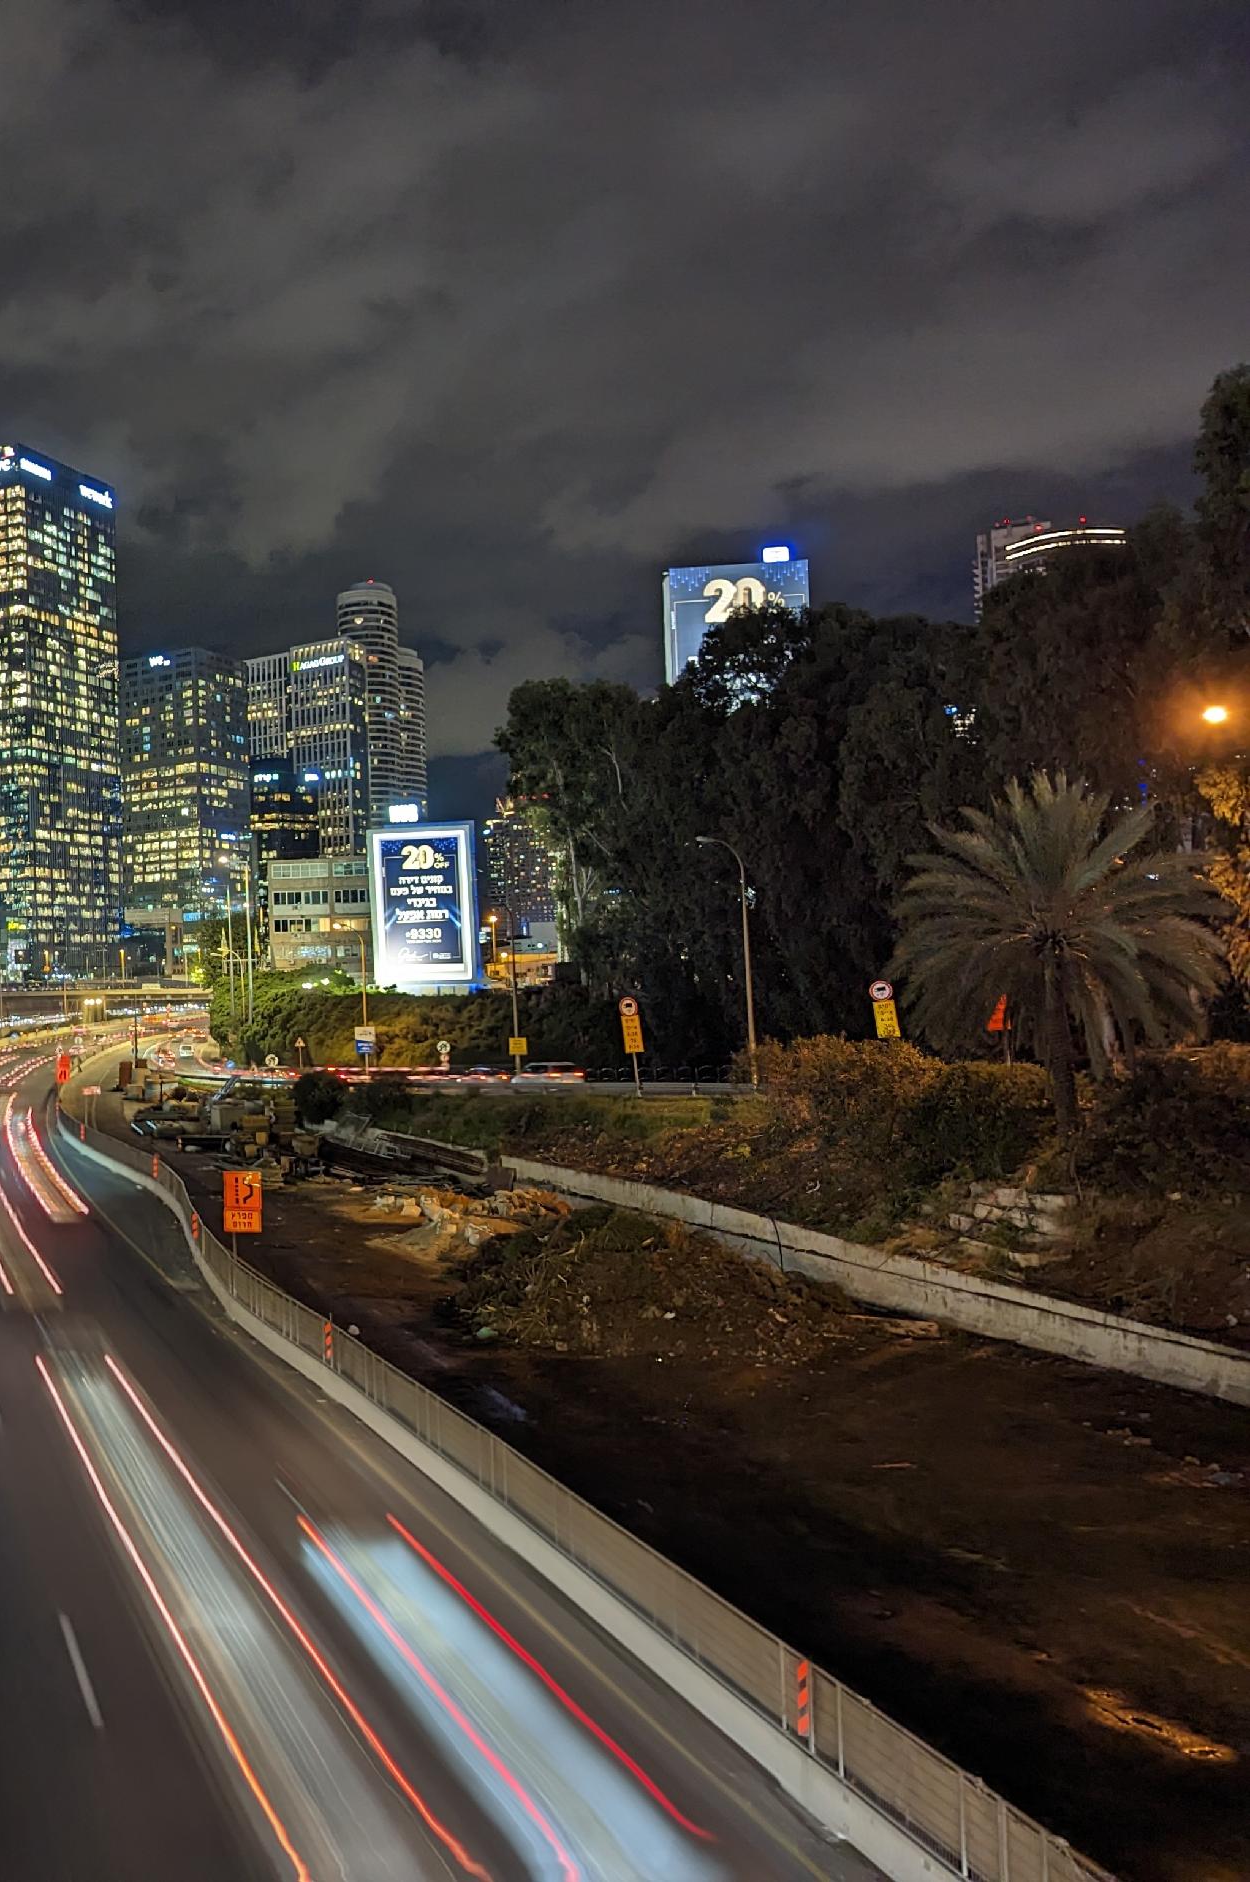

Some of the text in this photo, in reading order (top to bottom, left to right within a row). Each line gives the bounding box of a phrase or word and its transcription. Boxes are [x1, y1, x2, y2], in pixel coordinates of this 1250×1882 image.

[433, 861, 450, 869] OFF
[410, 884, 424, 895] של
[231, 1212, 253, 1220] מפרץ
